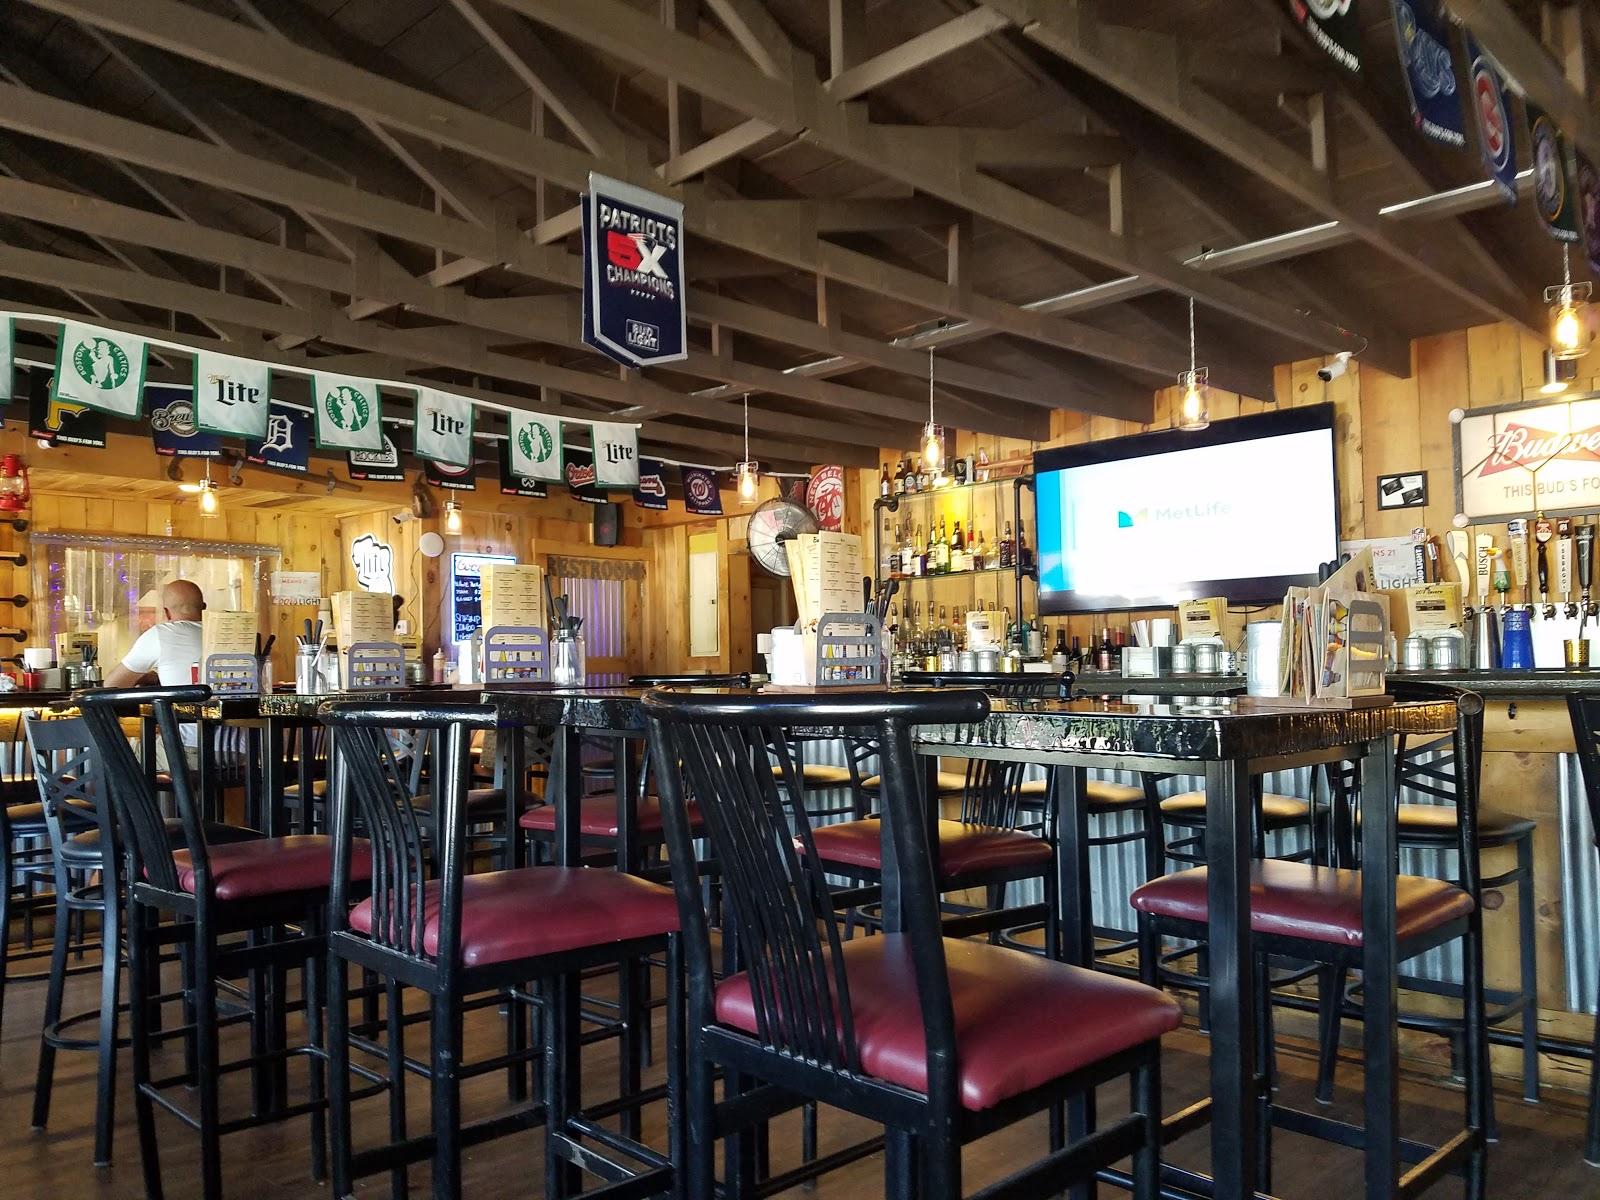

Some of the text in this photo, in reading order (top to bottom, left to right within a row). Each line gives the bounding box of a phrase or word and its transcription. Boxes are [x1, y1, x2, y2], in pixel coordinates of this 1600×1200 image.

[600, 203, 676, 251] PATRIOTS
[606, 264, 675, 300] CHAMPIONS
[628, 331, 658, 348] LIGHT
[632, 323, 654, 337] BUD
[113, 347, 129, 377] CELTICS
[216, 378, 260, 406] Lite
[431, 410, 464, 436] Lite
[605, 443, 633, 464] Lite
[1503, 484, 1533, 499] THIS
[1537, 479, 1578, 496] BUDS
[1155, 503, 1232, 520] MetLife
[1478, 546, 1489, 576] BUSCH
